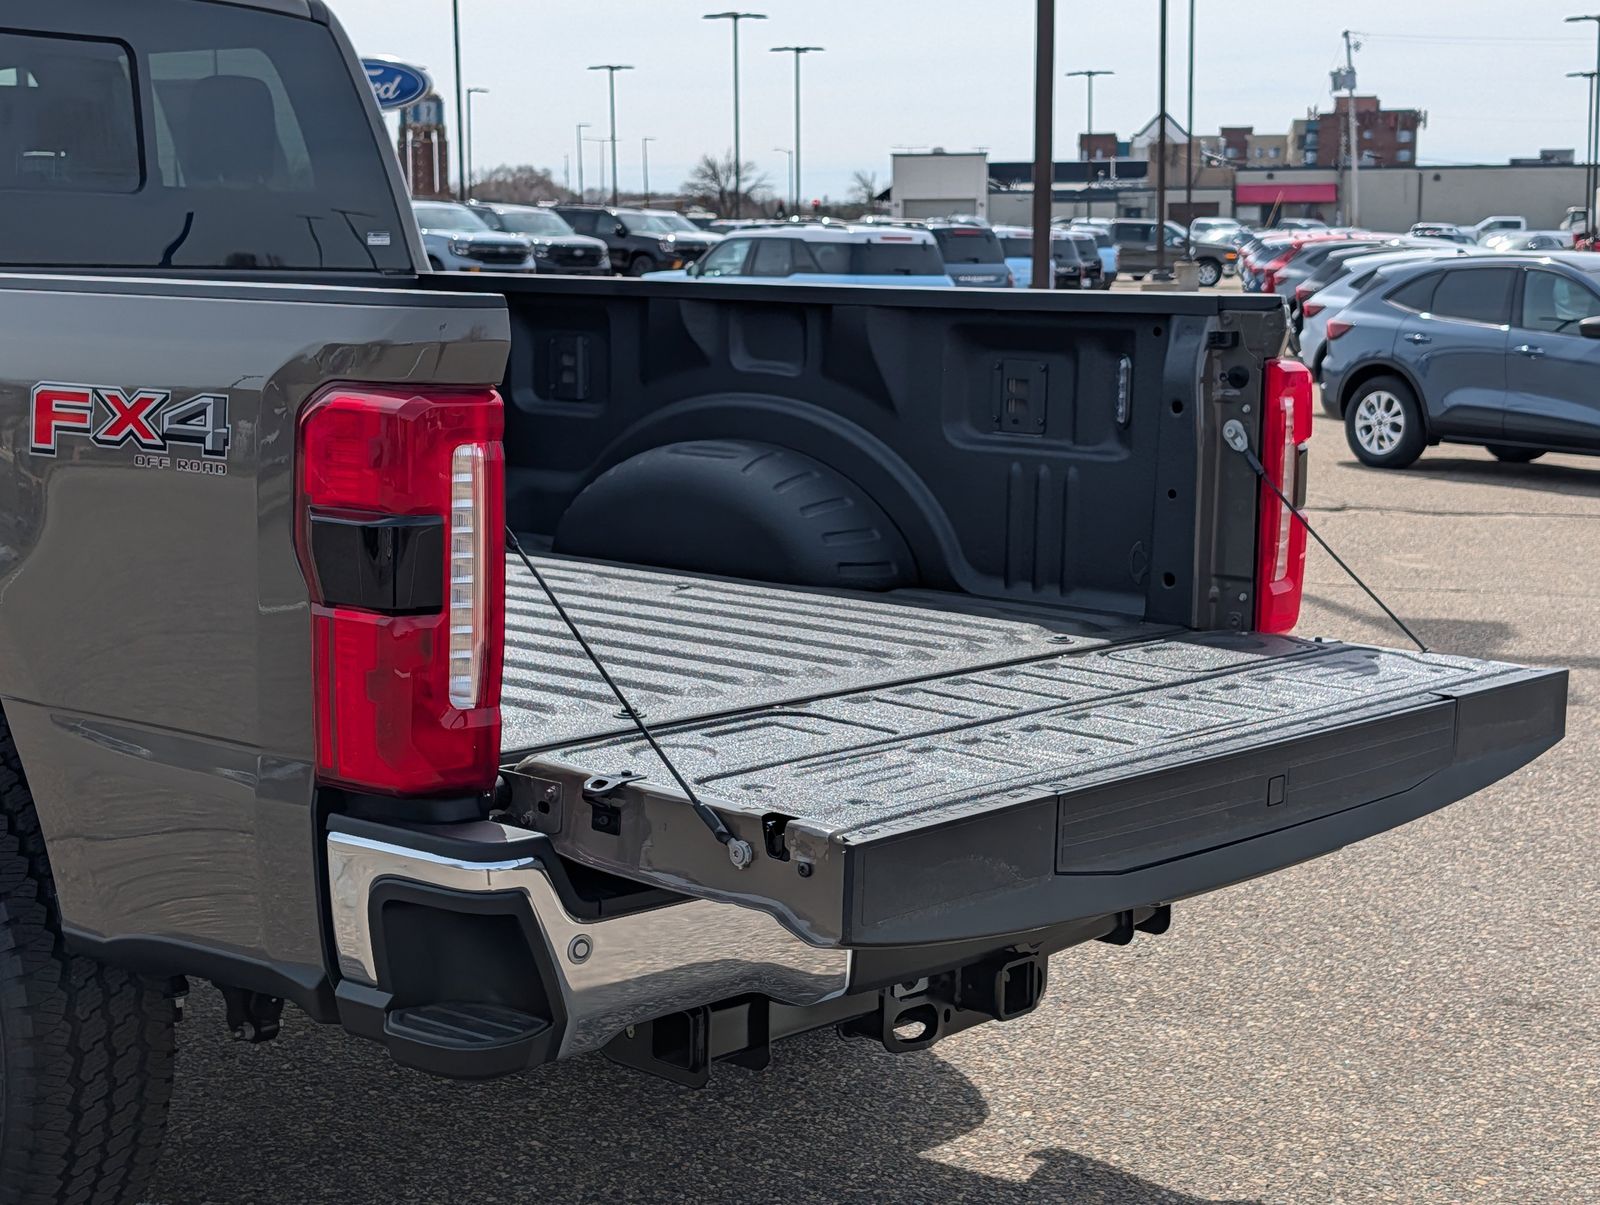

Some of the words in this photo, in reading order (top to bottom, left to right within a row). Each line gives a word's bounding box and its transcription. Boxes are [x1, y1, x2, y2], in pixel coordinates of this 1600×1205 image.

[30, 380, 231, 458] FX4
[134, 454, 171, 469] OFF
[176, 458, 228, 476] ROAD
